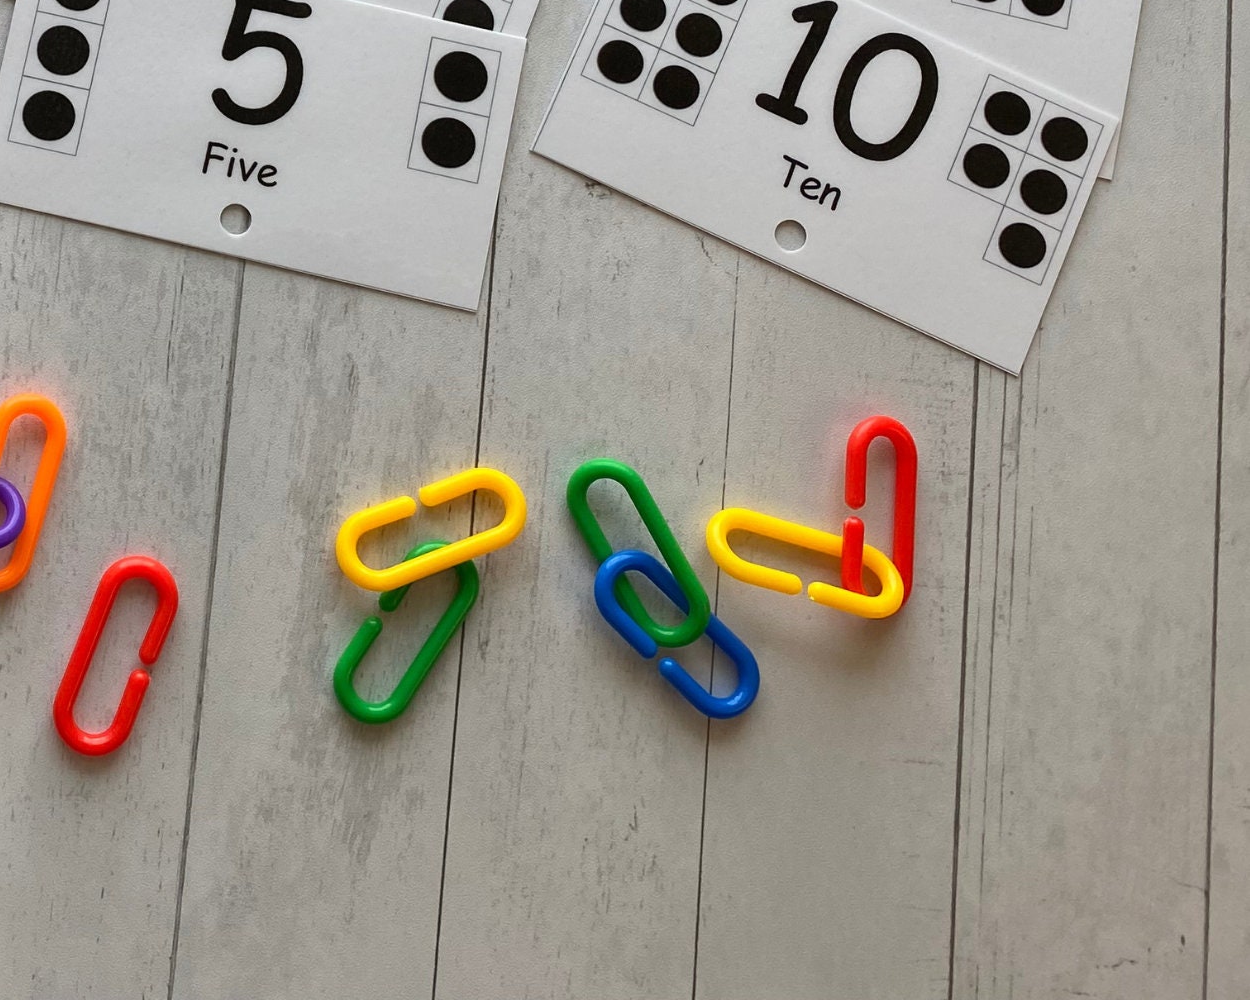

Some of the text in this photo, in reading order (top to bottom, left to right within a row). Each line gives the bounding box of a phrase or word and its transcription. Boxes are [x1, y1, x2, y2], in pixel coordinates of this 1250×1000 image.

[754, 0, 939, 162] 10
[201, 141, 278, 188] Five
[782, 154, 842, 211] Ten
